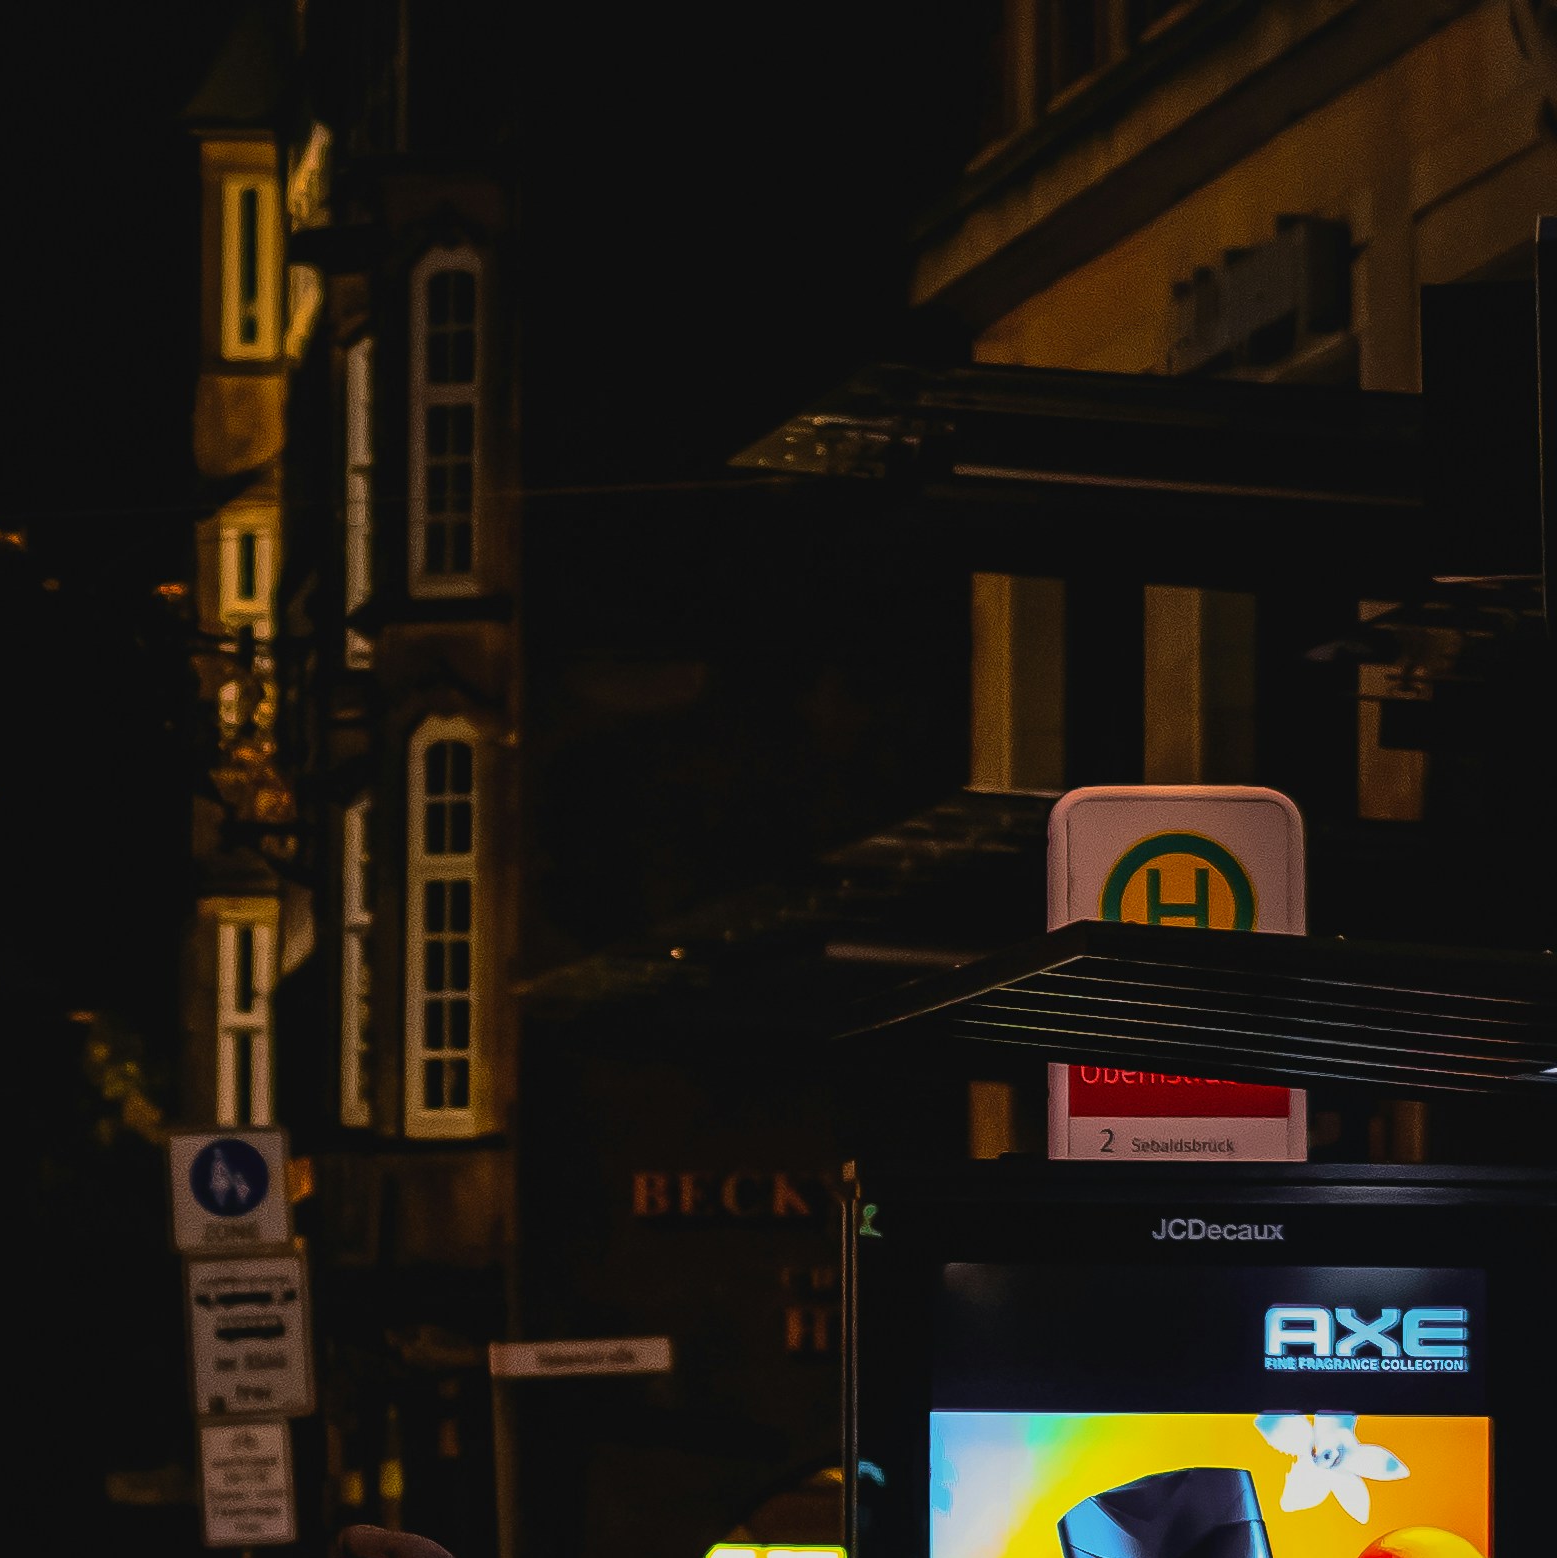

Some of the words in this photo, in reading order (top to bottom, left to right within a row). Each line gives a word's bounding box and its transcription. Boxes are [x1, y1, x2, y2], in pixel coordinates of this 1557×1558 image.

[1147, 868, 1209, 928] H
[1099, 1128, 1115, 1153] 2
[1151, 1217, 1284, 1240] JCDecaux
[1265, 1305, 1469, 1357] AXE
[1298, 1357, 1379, 1371] FRAGRANCE
[1381, 1358, 1467, 1371] COLLECTION
